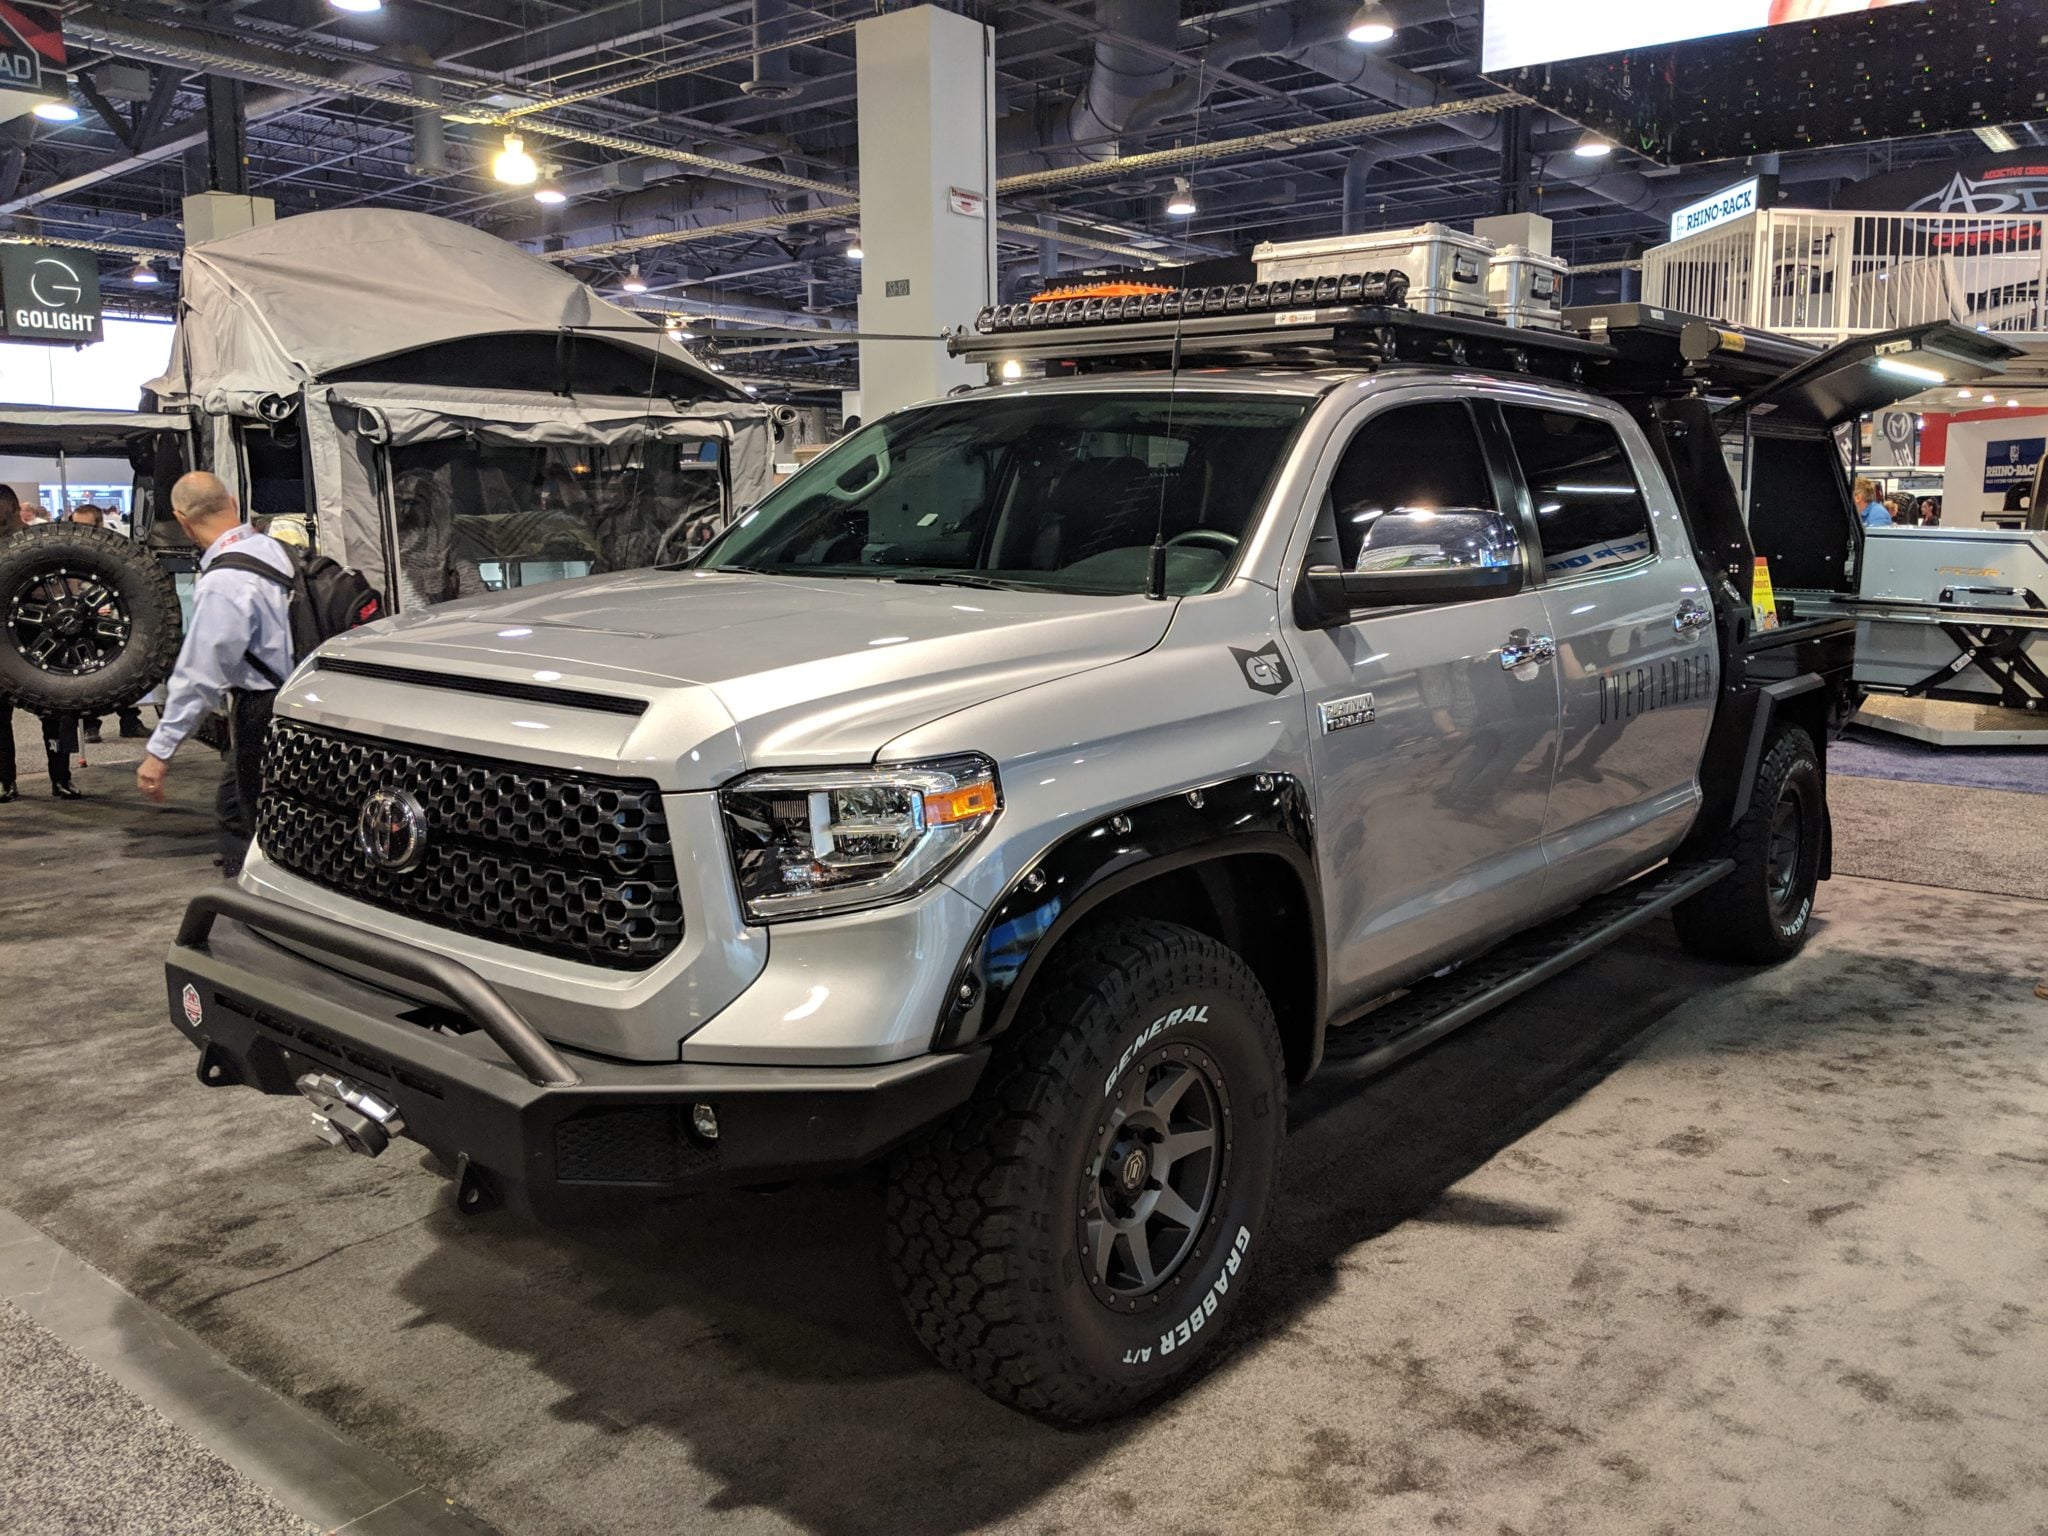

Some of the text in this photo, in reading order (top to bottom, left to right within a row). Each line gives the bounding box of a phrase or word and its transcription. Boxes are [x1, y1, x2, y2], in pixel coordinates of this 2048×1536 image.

[1686, 190, 1752, 231] RHINO-RACK
[16, 309, 95, 332] GOLIGHT
[1600, 653, 1711, 726] OVERLANDER
[1787, 897, 1810, 937] GENERAL
[1104, 1005, 1209, 1098] GENERAL
[1122, 1225, 1251, 1364] GRABBER A/T
